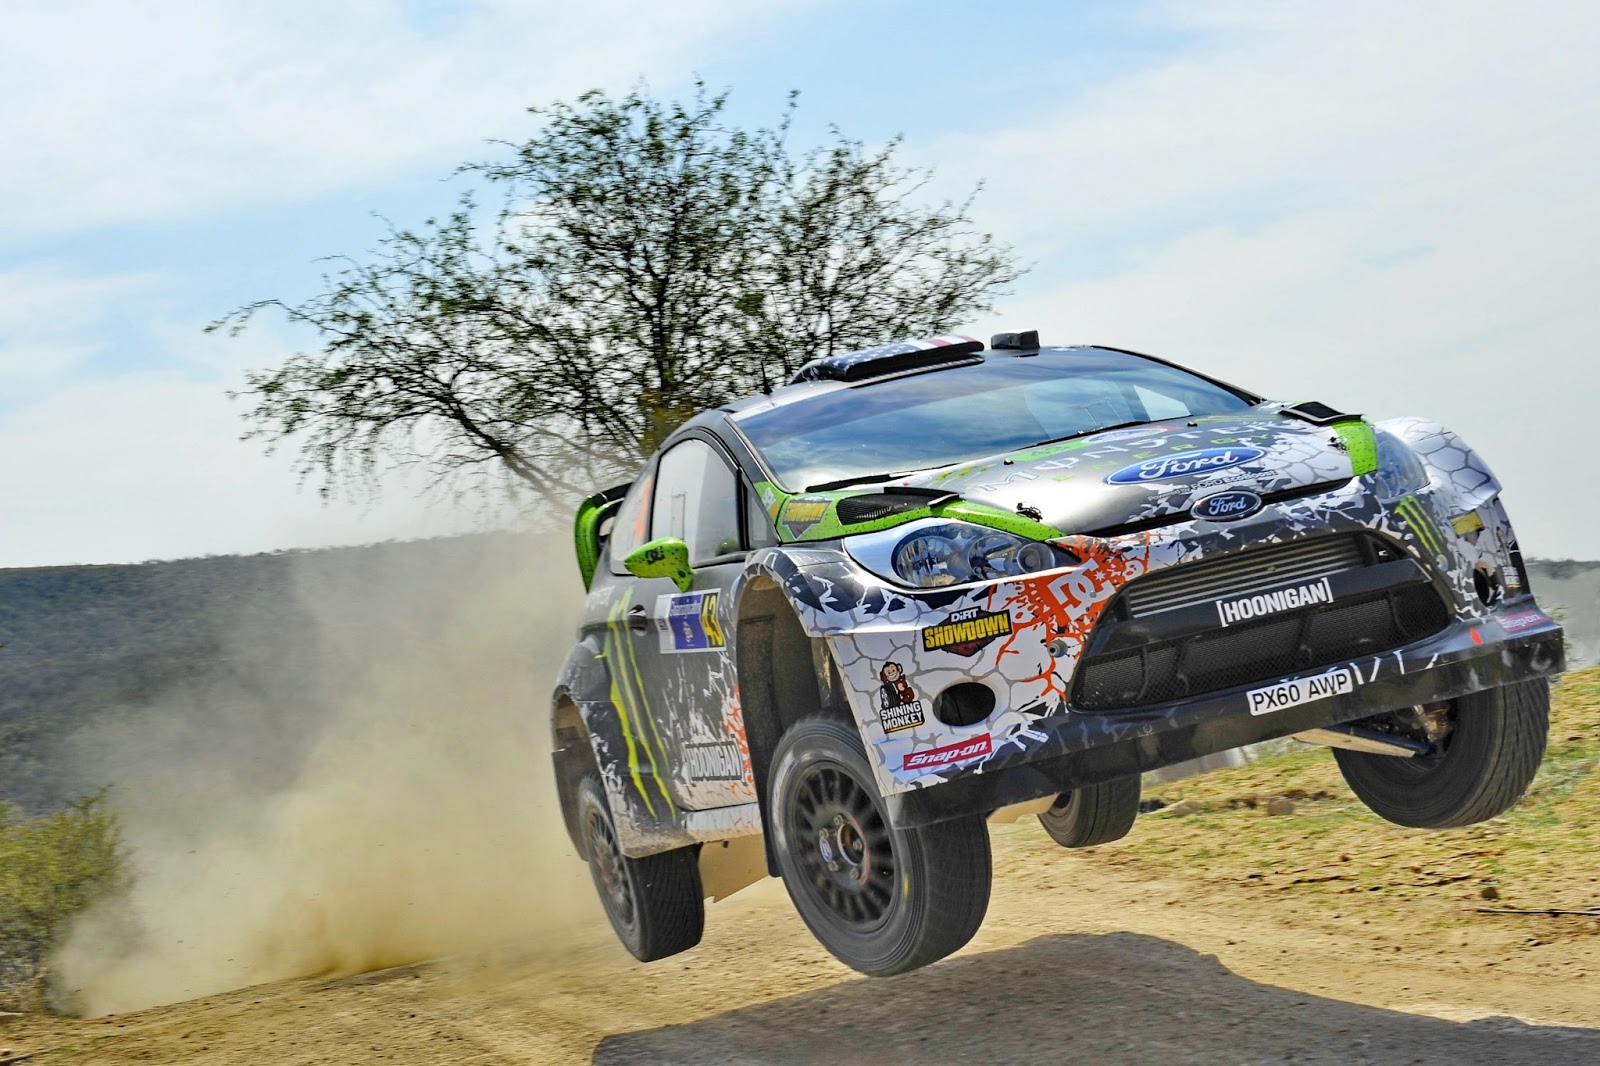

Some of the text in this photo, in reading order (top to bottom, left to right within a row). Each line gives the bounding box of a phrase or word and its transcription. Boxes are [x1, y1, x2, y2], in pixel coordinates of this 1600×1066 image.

[1138, 451, 1240, 479] Ford
[1148, 469, 1279, 501] Powered by FORD EcoBoost
[1208, 495, 1247, 515] Ford
[1046, 557, 1117, 621] DC
[950, 608, 979, 623] DiRT
[924, 612, 1010, 648] SHOWDOWN
[1251, 673, 1348, 711] PX60 AWP
[880, 701, 921, 720] SHINING
[882, 711, 923, 731] MONKEY
[907, 740, 987, 767] Snap-on
